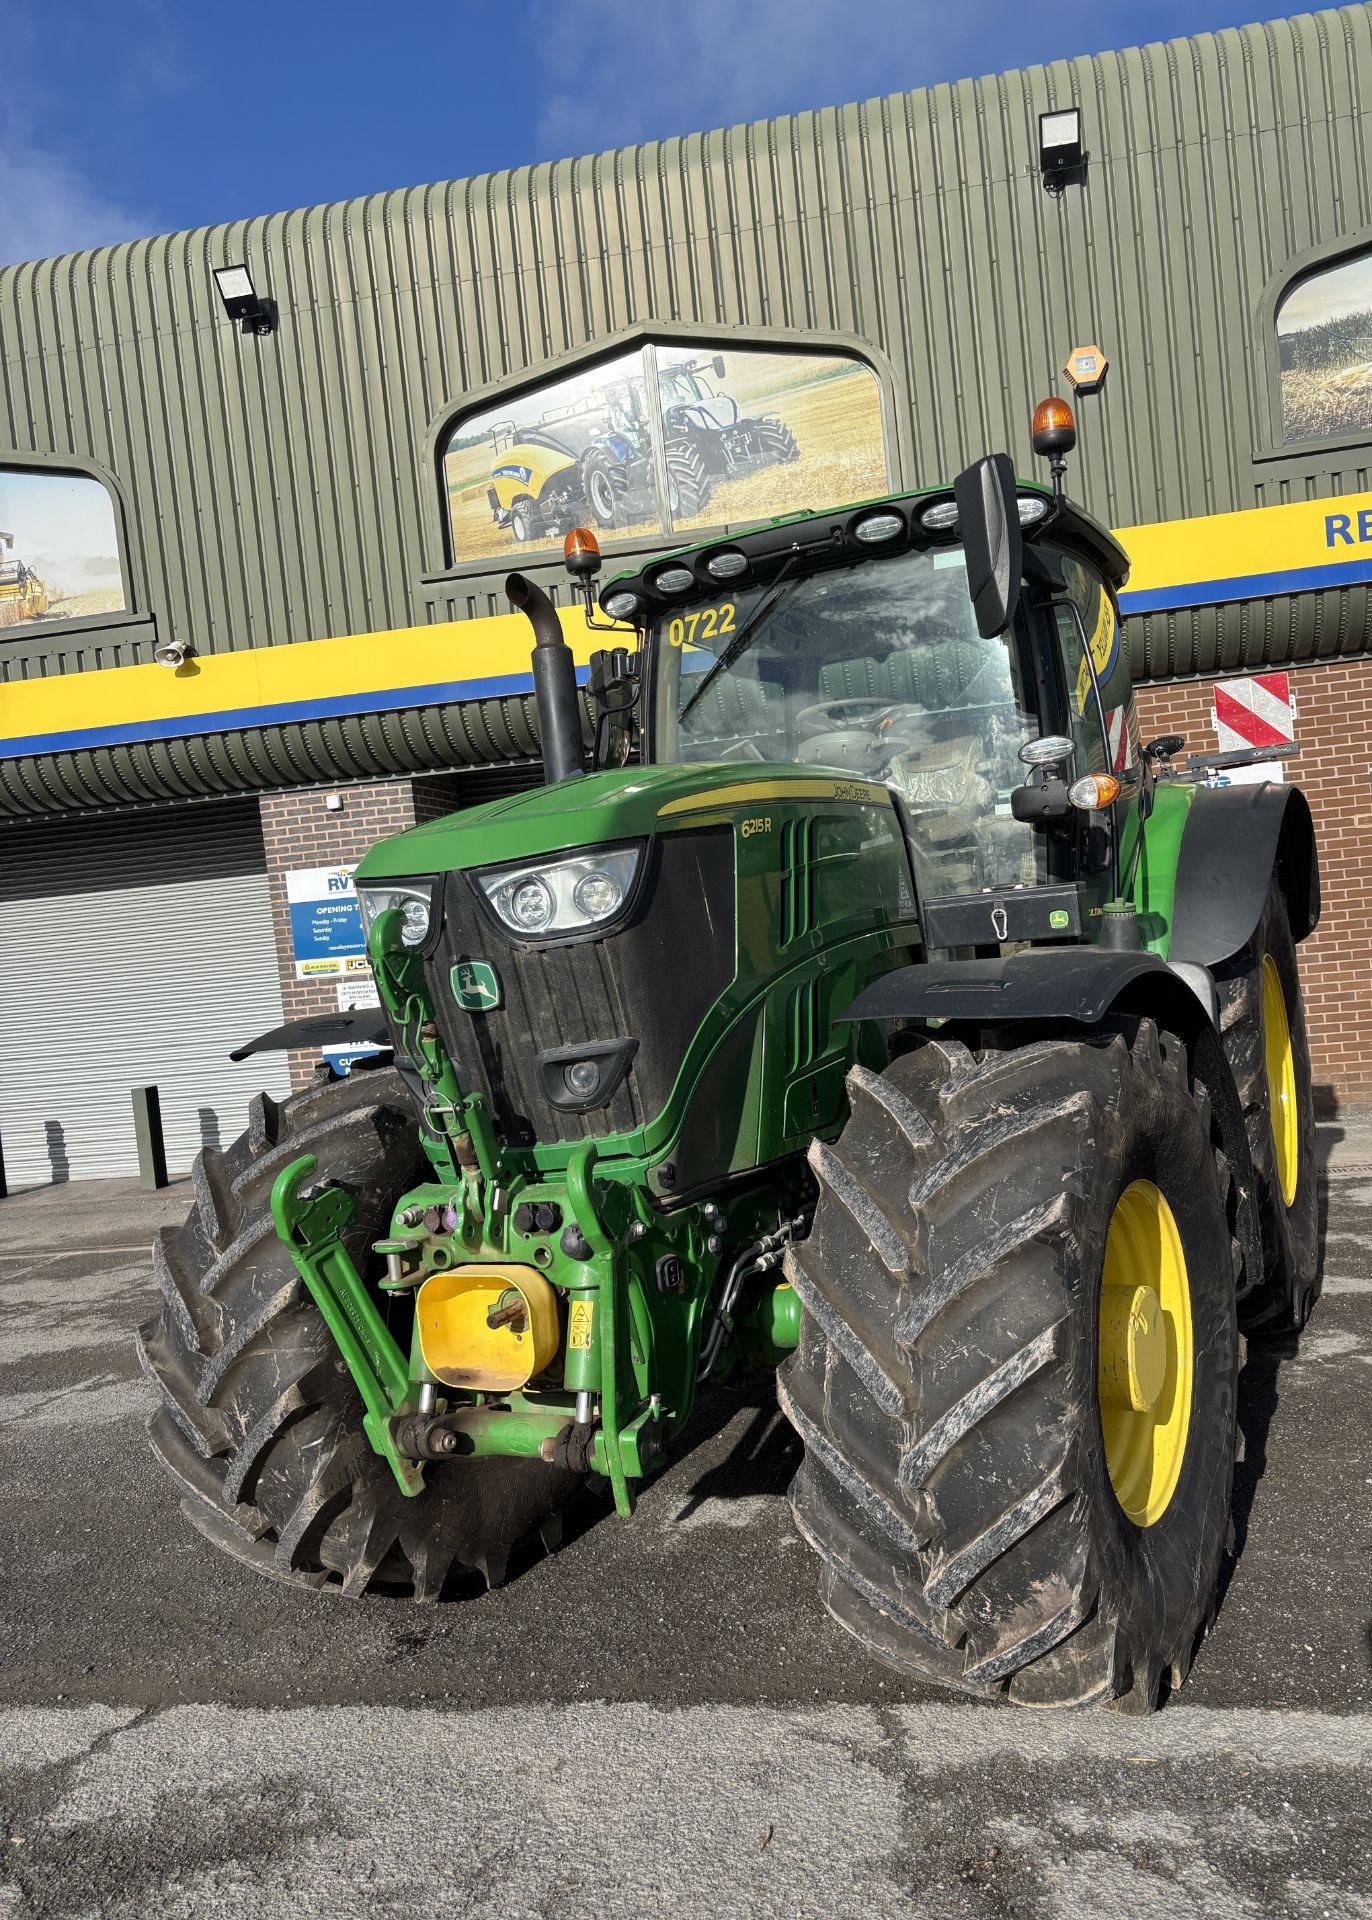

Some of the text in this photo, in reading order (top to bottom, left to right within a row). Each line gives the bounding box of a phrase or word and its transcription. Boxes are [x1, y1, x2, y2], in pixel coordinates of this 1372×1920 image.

[1325, 509, 1372, 548] RE
[669, 603, 736, 647] 0722
[741, 817, 772, 838] 6215R
[316, 904, 353, 915] OPENING
